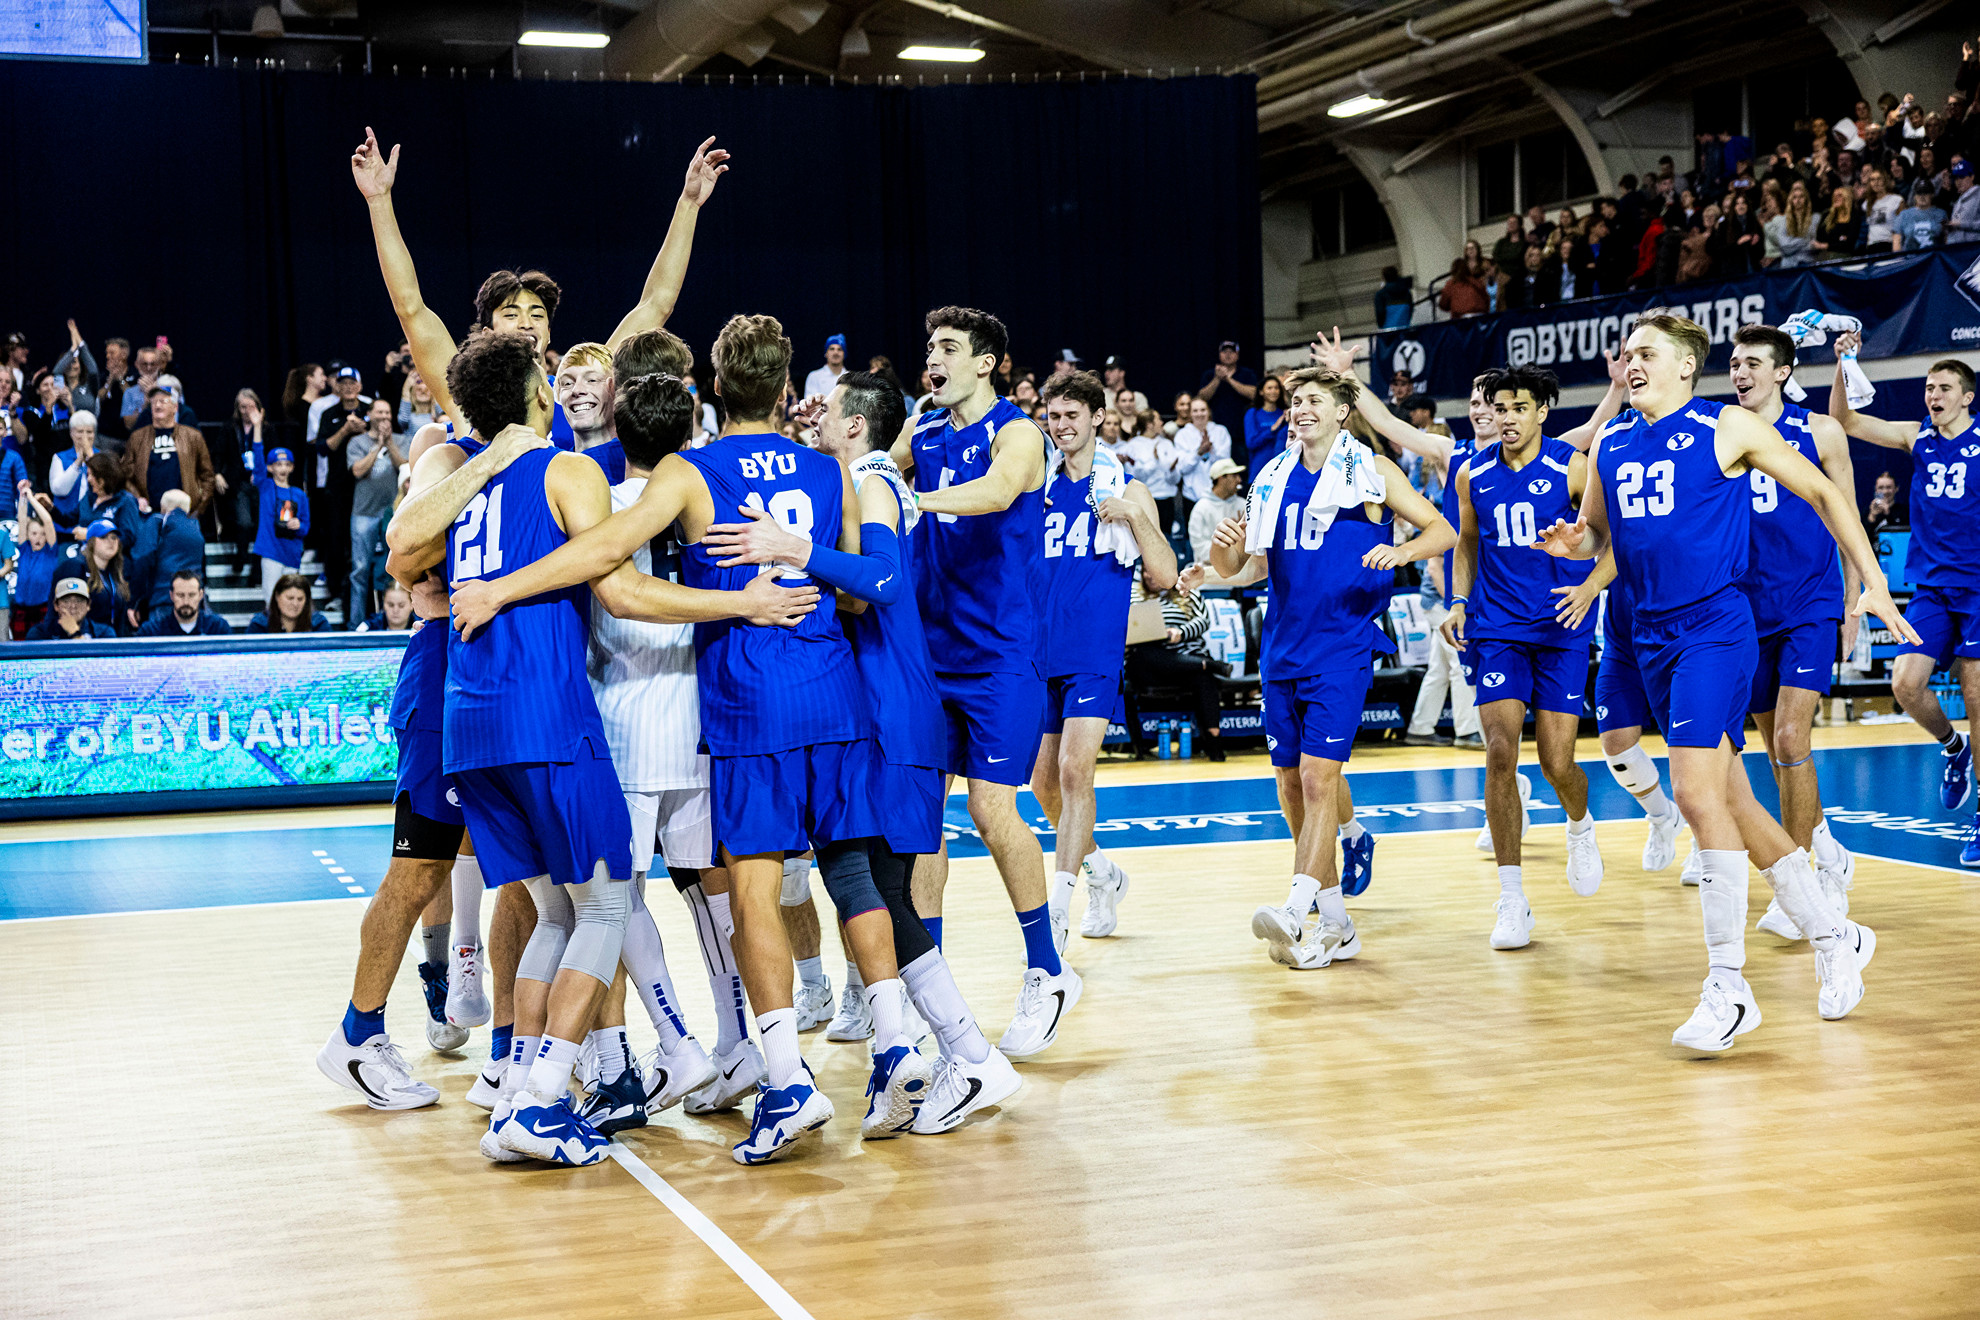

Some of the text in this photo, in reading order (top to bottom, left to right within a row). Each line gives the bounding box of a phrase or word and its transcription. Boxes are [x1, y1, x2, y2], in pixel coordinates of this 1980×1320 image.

[1507, 294, 1765, 370] @BYUCARS
[738, 450, 797, 481] BYU
[1616, 459, 1675, 519] 23
[1925, 462, 1967, 499] 33
[1750, 468, 1778, 514] 9
[453, 483, 504, 583] 21
[1044, 511, 1090, 558] 24
[1494, 502, 1537, 547] 10
[69, 713, 119, 757] of
[132, 710, 231, 754] BYU
